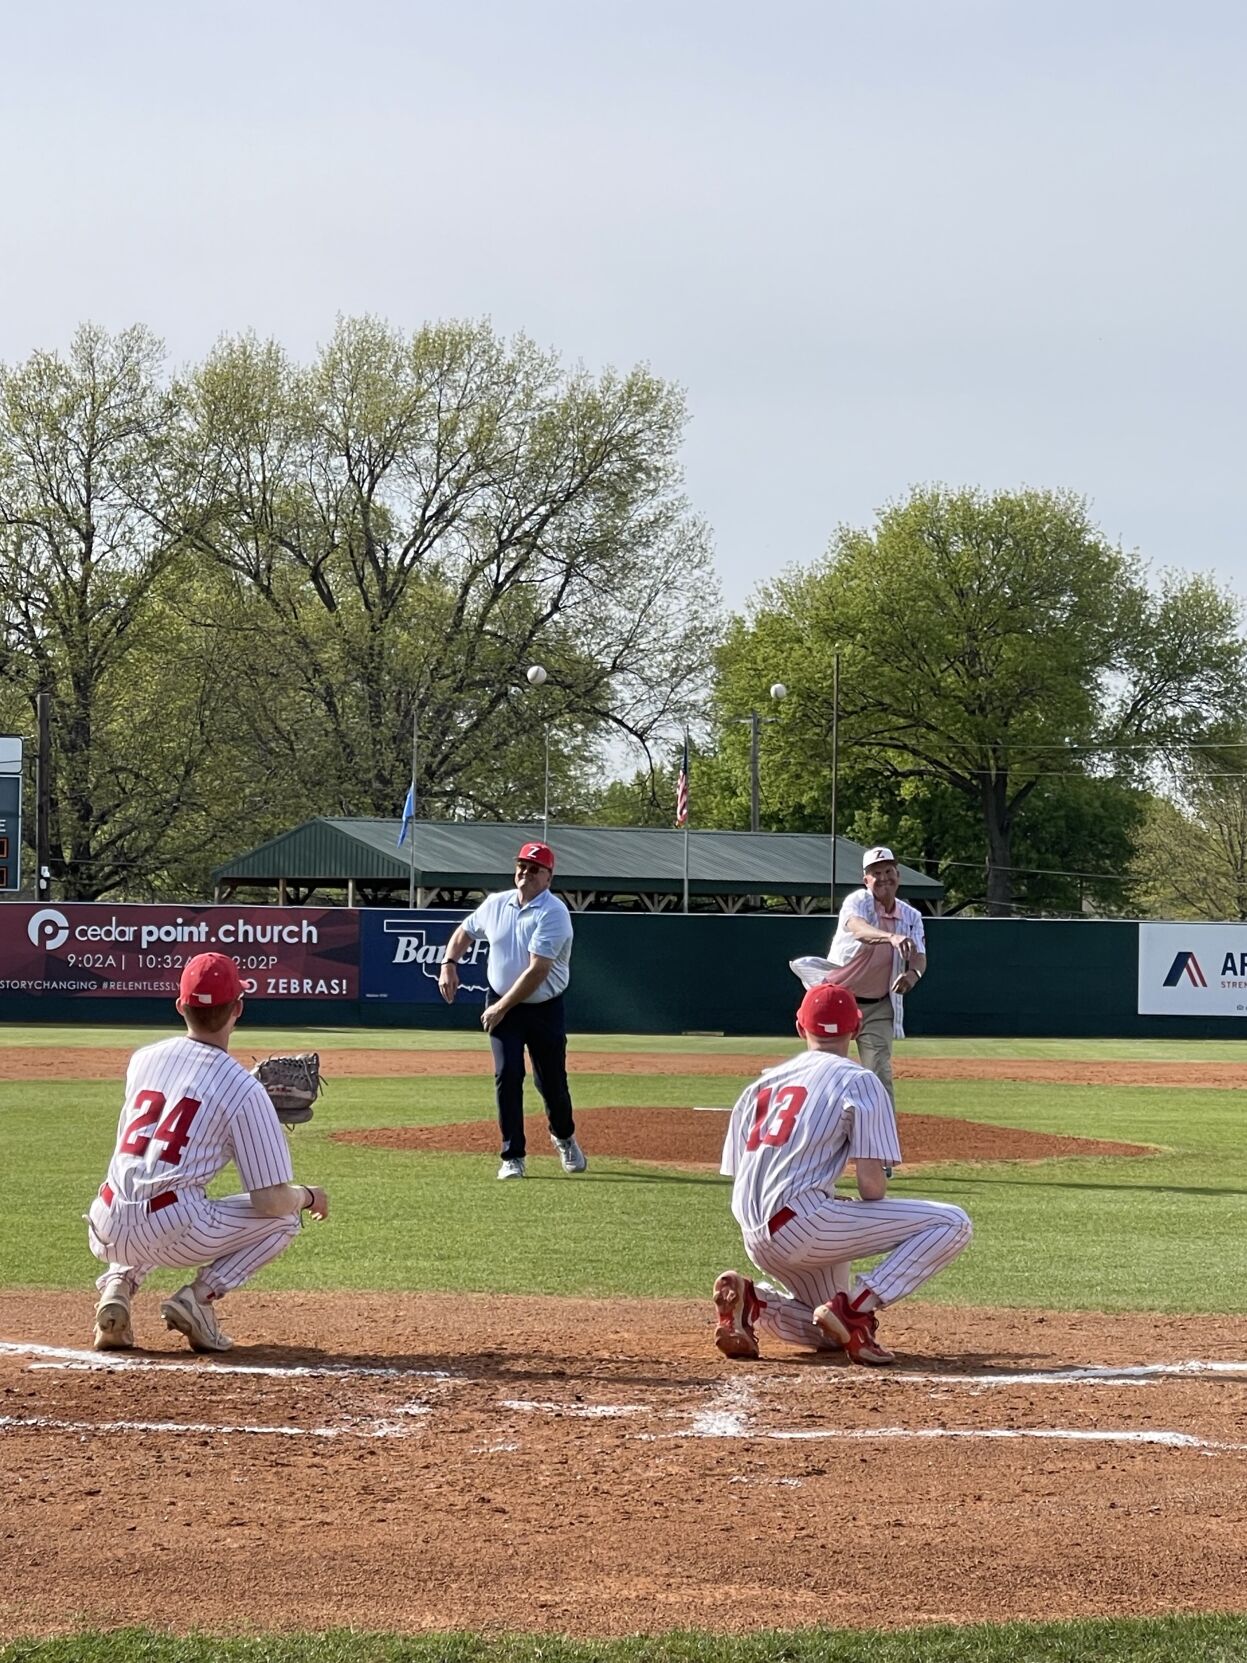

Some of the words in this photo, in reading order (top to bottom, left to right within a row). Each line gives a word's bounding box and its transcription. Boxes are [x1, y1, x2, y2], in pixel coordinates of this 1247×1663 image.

[527, 846, 540, 858] Z
[75, 916, 138, 942] cedar
[67, 953, 117, 968] 9:02A
[233, 955, 278, 970] 2:02P
[267, 978, 347, 995] ZEBRAS!
[119, 1089, 203, 1166] 24
[746, 1085, 809, 1152] 13
